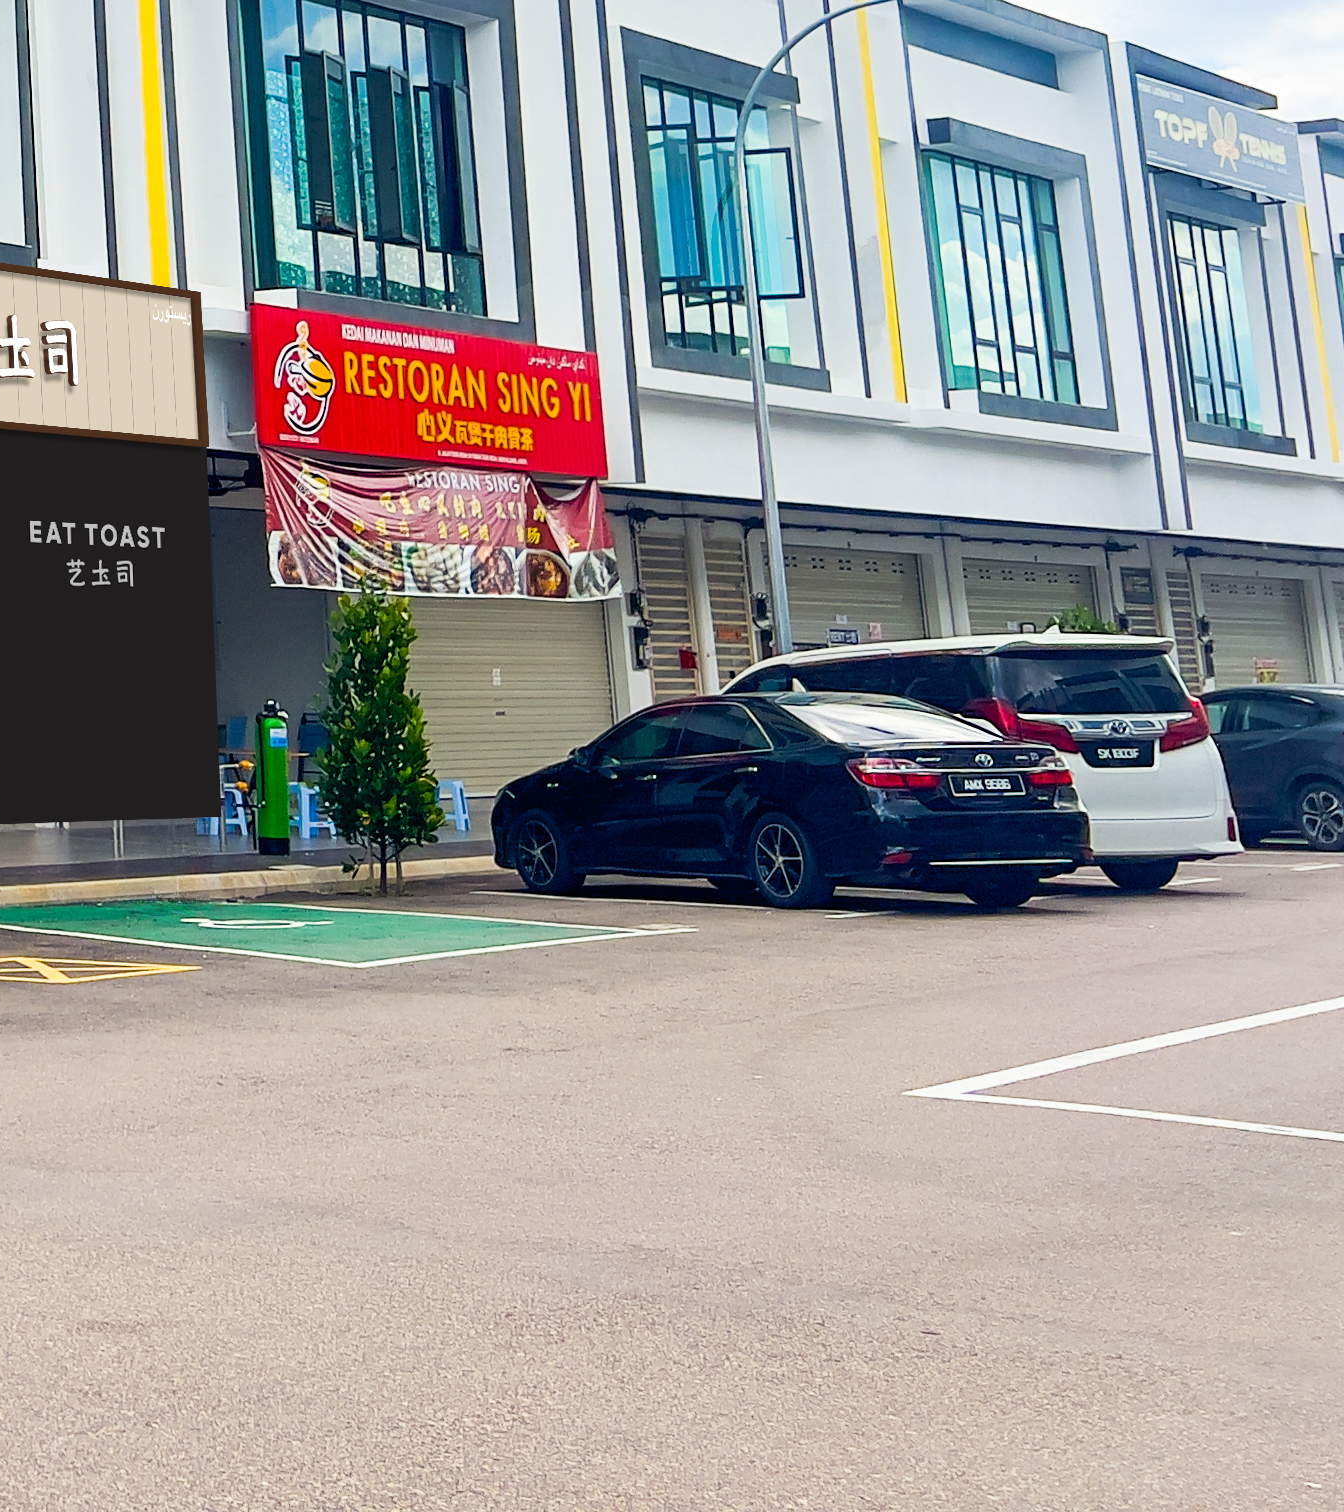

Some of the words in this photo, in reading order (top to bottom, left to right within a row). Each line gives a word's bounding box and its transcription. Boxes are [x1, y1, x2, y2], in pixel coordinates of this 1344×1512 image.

[341, 323, 365, 341] KEDAI
[343, 350, 488, 412] RESTORAN
[496, 371, 561, 419] SING
[567, 380, 593, 422] YI
[485, 474, 520, 494] SING
[29, 520, 76, 545] EAT
[84, 523, 166, 549] TOAST
